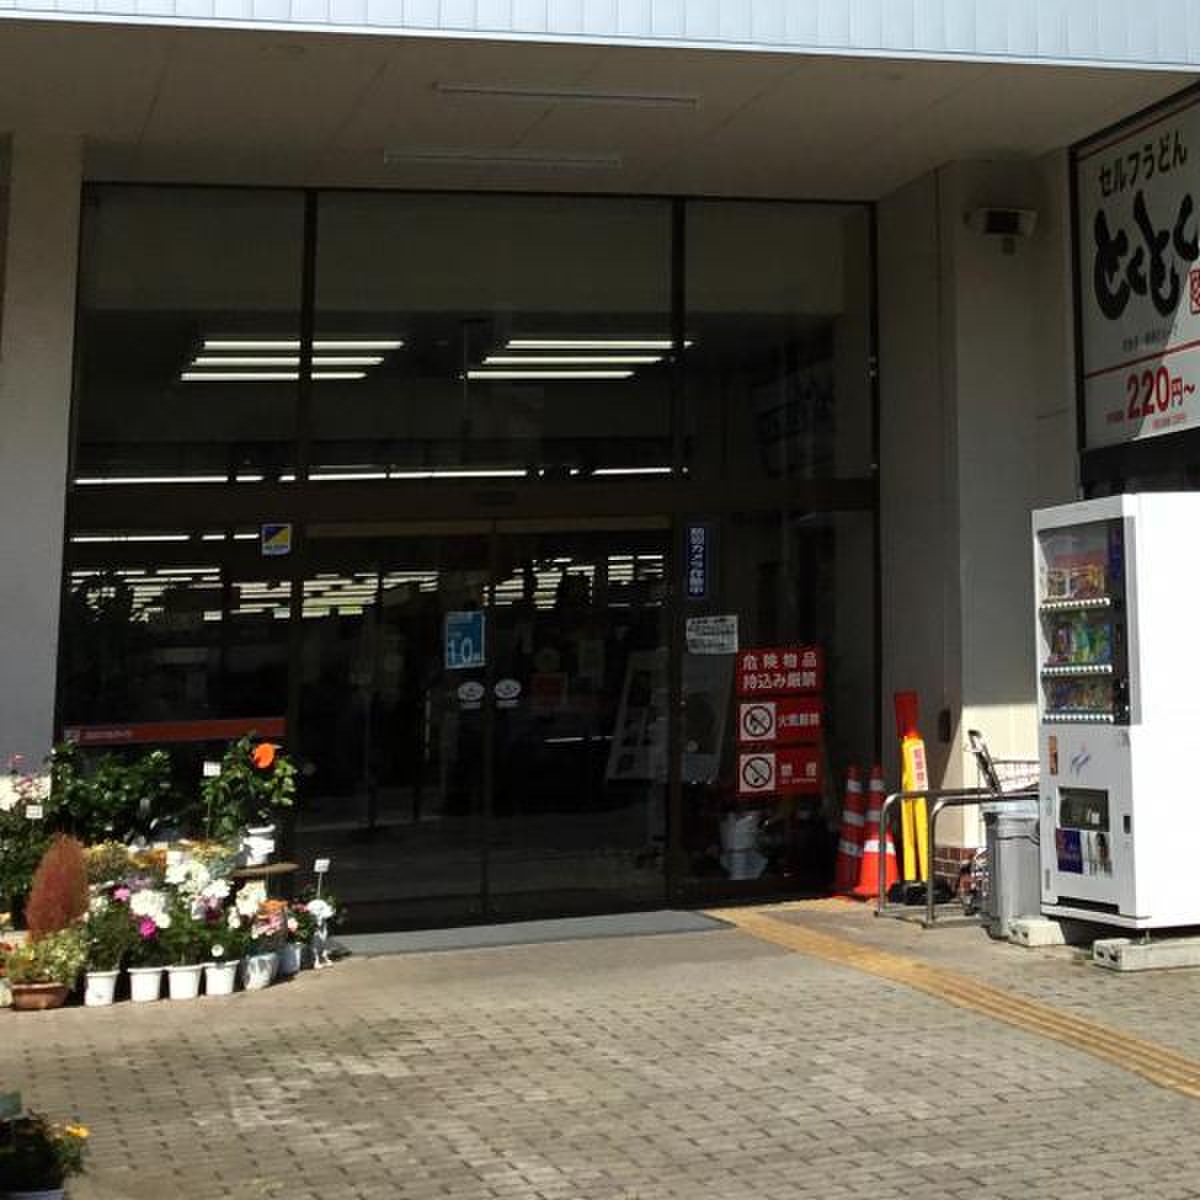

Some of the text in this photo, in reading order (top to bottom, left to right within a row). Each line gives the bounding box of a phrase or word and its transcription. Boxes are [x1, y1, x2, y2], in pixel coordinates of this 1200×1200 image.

[1098, 131, 1188, 198] セルフうどん
